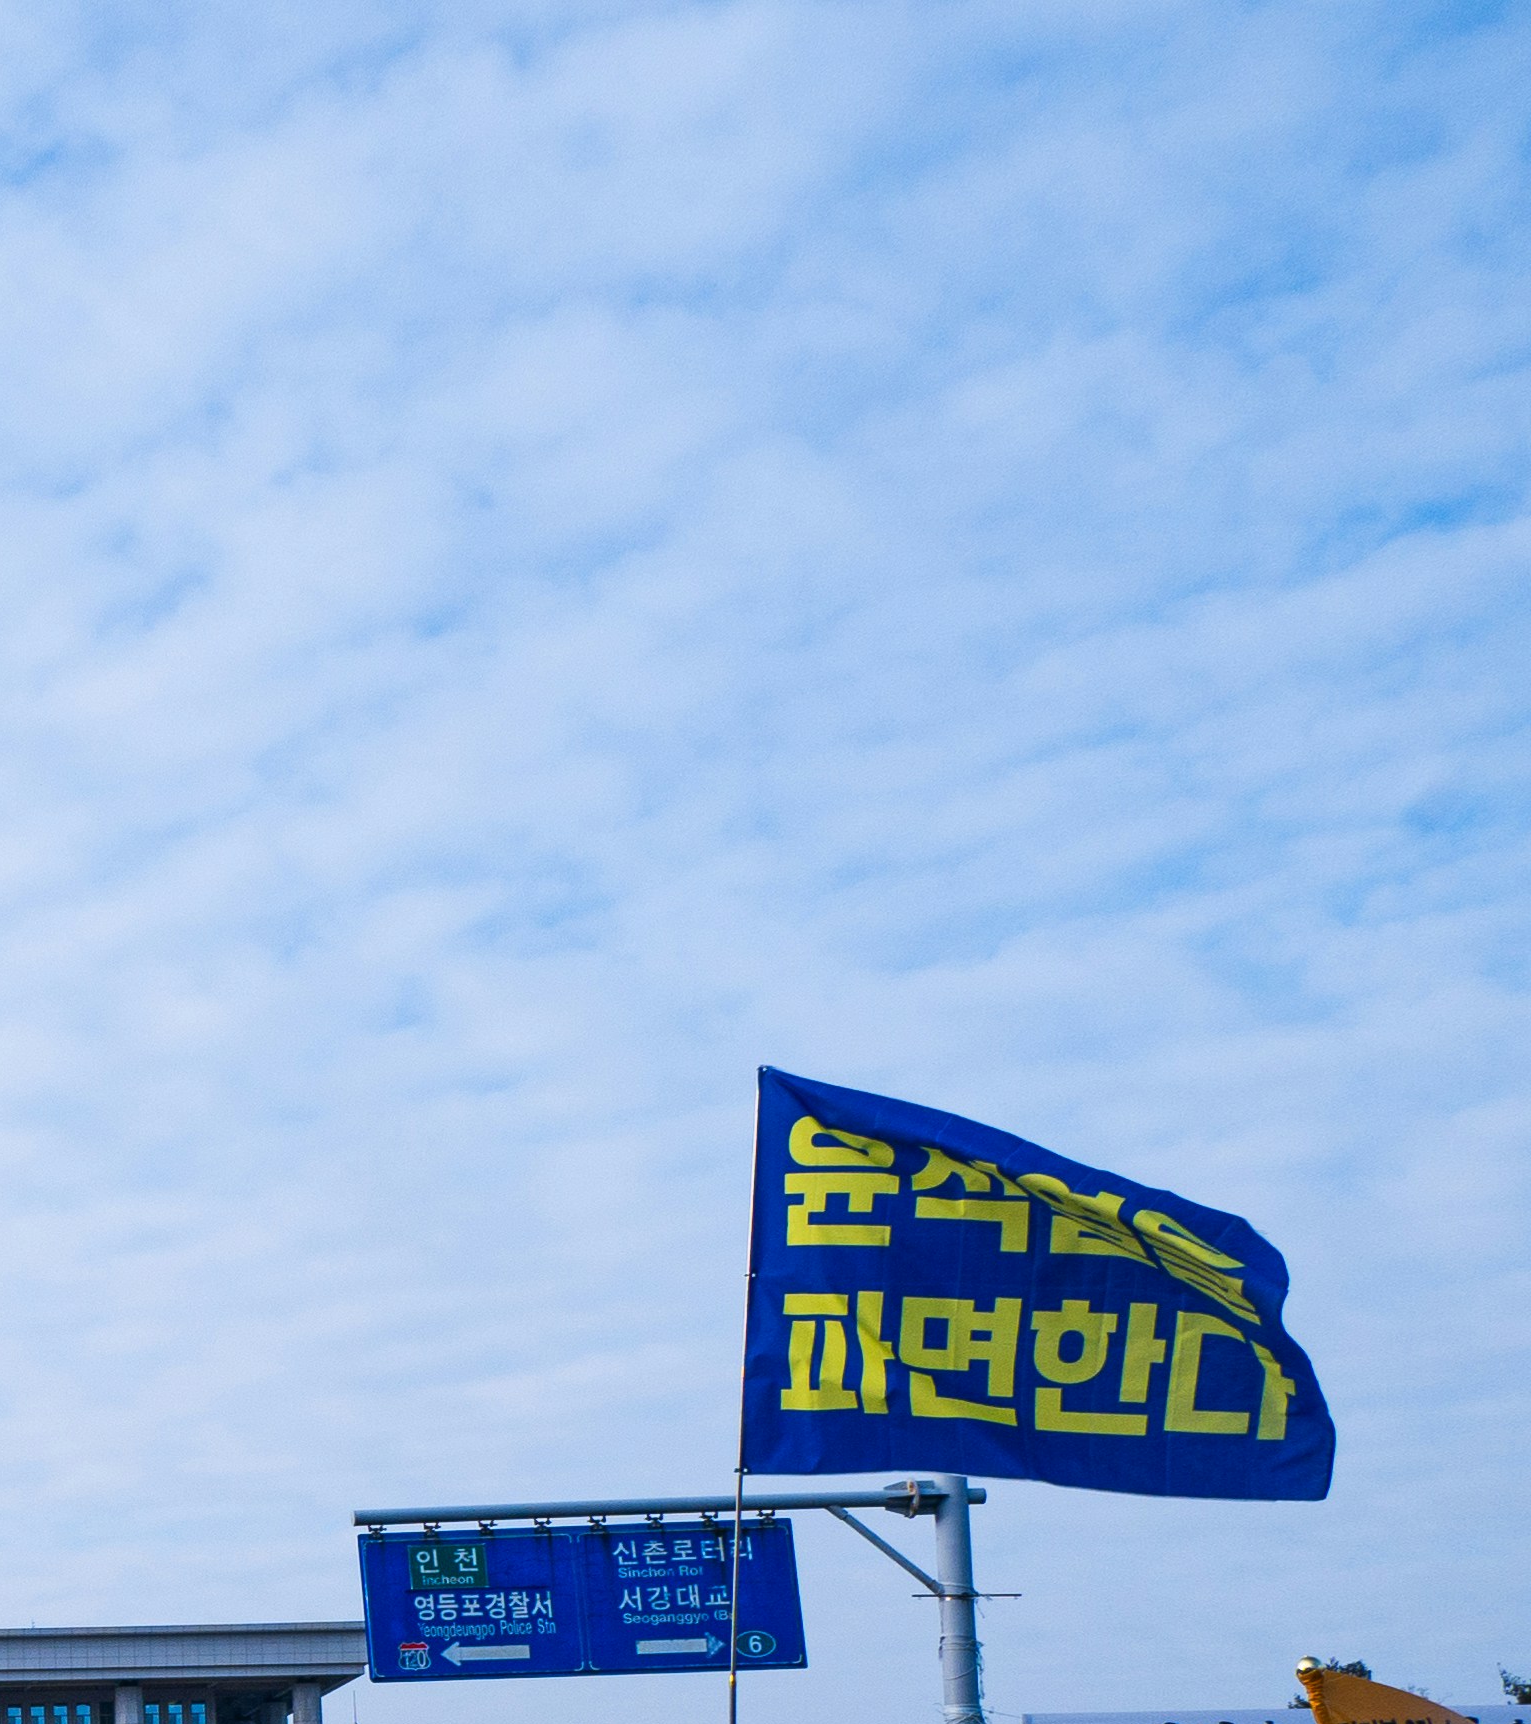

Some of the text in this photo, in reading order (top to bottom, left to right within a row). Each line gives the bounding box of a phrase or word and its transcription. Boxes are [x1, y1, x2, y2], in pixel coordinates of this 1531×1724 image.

[780, 1290, 1296, 1441] 파면한다
[415, 1548, 480, 1574] 인천
[612, 1536, 754, 1566] 신촌로터리
[618, 1566, 675, 1579] Sinchon
[414, 1590, 554, 1621] 영등포경찰서
[619, 1583, 731, 1612] 서강대교
[418, 1617, 557, 1641] Yeongdeungpo Police Stn
[748, 1635, 762, 1653] 6
[402, 1650, 426, 1668] 120
